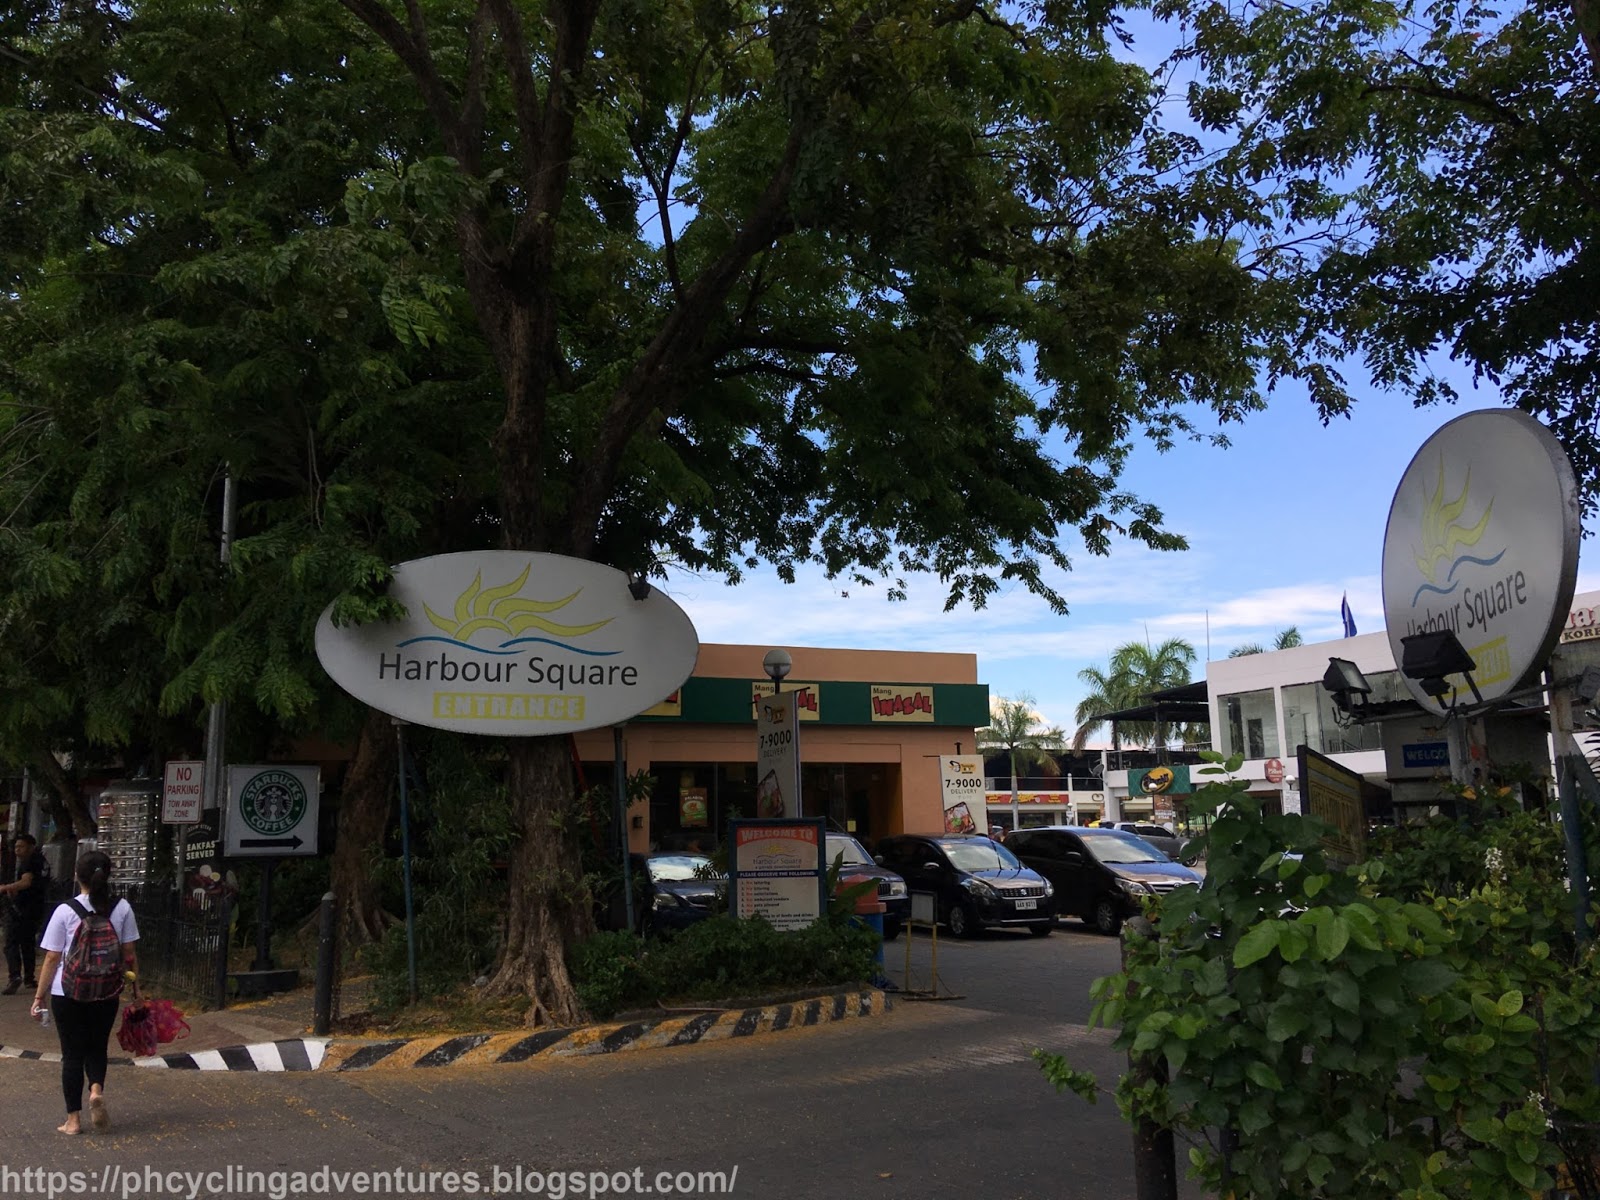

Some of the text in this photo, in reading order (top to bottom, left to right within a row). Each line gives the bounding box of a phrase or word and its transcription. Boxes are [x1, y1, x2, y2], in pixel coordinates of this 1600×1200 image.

[1463, 570, 1527, 632] Square
[379, 651, 638, 691] Harbour Square
[754, 685, 775, 693] Mang
[873, 687, 892, 695] Mang
[439, 694, 581, 720] ENTRANCE
[760, 729, 792, 749] 7-9000
[176, 767, 192, 781] NO
[246, 774, 303, 801] STARBUCKS
[945, 778, 982, 788] 7-9000
[167, 785, 199, 795] PARKING
[168, 800, 196, 808] TOW AWAY
[174, 810, 189, 818] ZONE
[251, 815, 293, 831] COFFEE
[741, 828, 813, 841] WELCOME TO
[186, 849, 215, 860] SERVED
